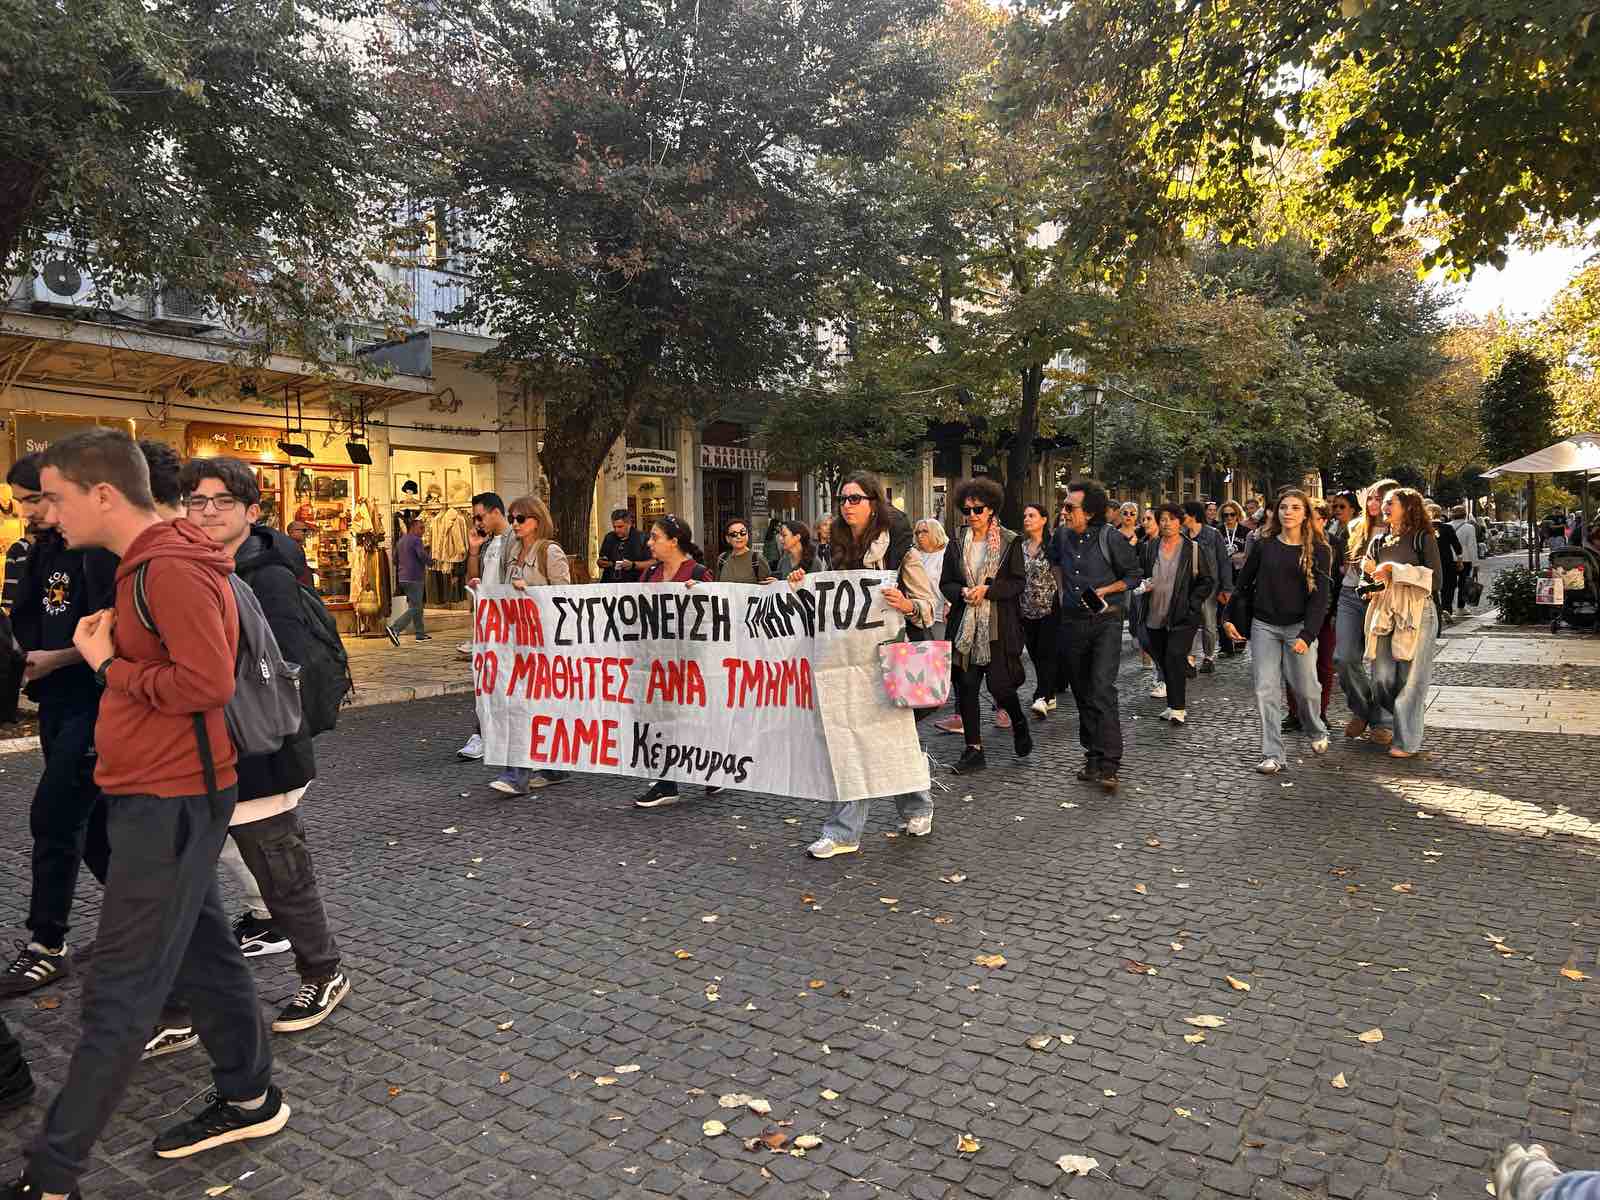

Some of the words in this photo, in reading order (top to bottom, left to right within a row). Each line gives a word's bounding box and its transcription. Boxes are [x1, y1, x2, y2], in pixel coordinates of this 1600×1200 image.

[26, 439, 48, 452] Swi
[475, 598, 544, 647] ΚΑΜΙΑ
[552, 594, 731, 645] ΣΥΓΧΩΝΕΥΣΗ
[474, 650, 498, 697] 20
[506, 652, 634, 704] ΜΑΘΗΤΕΣ
[646, 657, 706, 707] ΑΝΑ
[722, 656, 814, 710] ΤΜΗΜΑ
[530, 716, 619, 767] ΕΛΜΕ
[630, 722, 754, 784] Κέρκυρας
